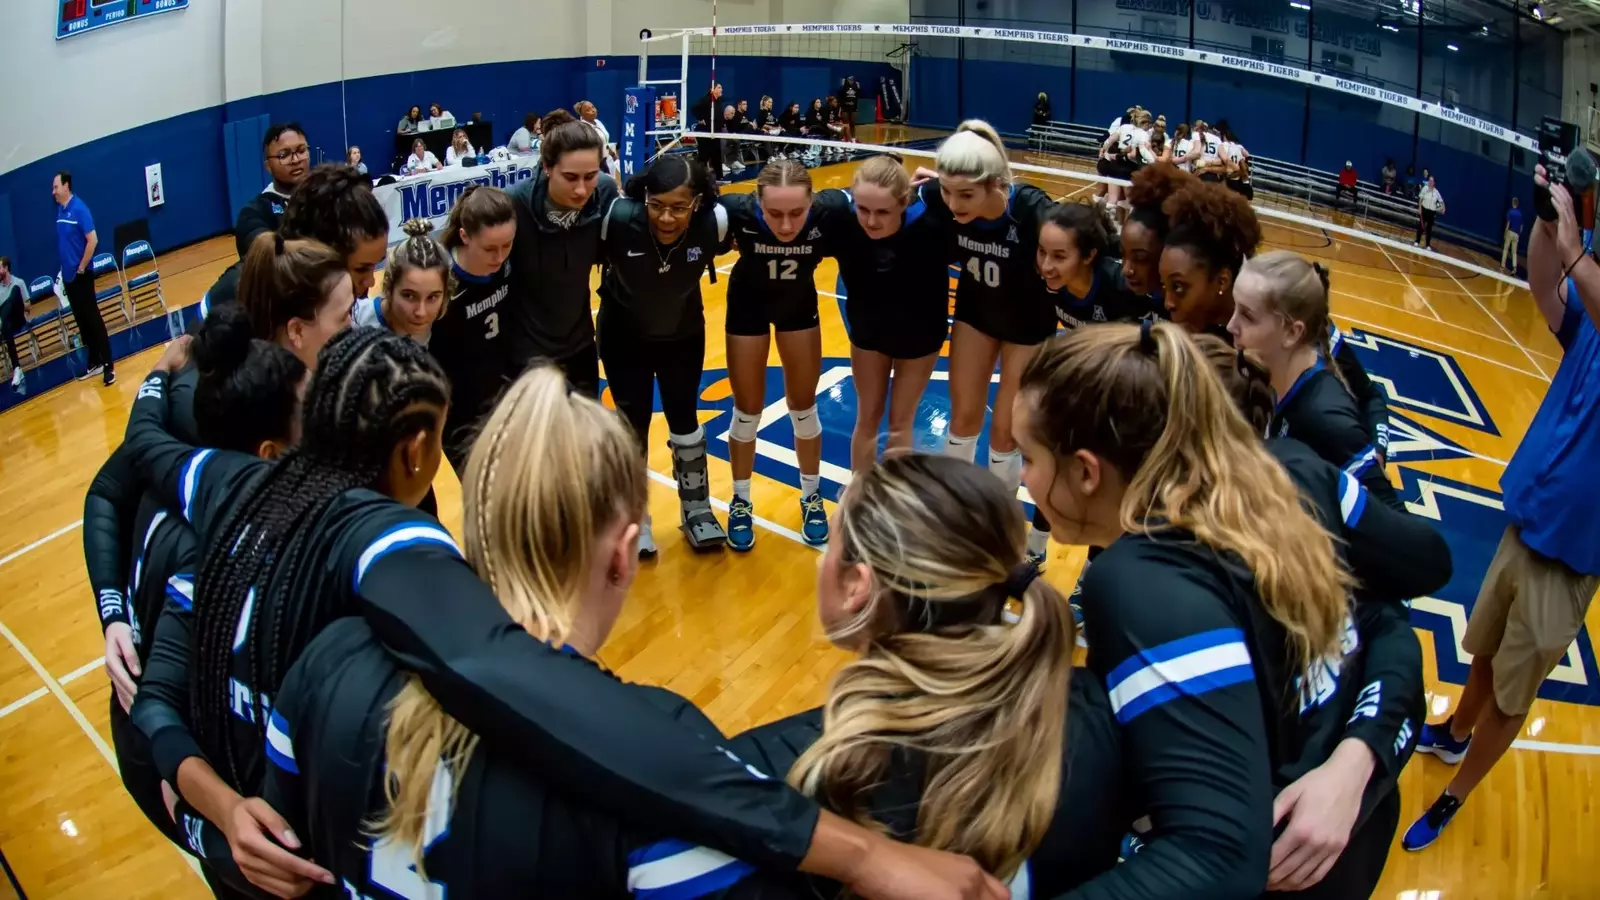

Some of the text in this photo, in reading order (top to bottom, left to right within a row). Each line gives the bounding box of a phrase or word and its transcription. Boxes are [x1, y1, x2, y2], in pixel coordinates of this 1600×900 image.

[105, 10, 125, 20] PERIOD
[68, 19, 89, 31] BONUS
[893, 25, 960, 34] MEMPHIS TIGERS
[994, 29, 1069, 42] MEMPHIS TIGERS
[1106, 39, 1185, 57] MEMPHIS TIGERS
[1222, 56, 1300, 78] MEMPHIS TIGERS
[1335, 79, 1408, 105] MEMPHIS TIGERS
[1440, 108, 1504, 136] MEMPHIS TIGERS
[1123, 134, 1133, 146] 2
[1204, 142, 1216, 155] 15
[125, 244, 148, 256] Memphis
[754, 243, 813, 257] Memphis
[957, 234, 1010, 258] Memphis
[93, 257, 112, 268] emphis
[767, 259, 799, 280] 12
[966, 256, 1000, 288] 40
[465, 284, 509, 320] Memphis
[484, 312, 500, 340] 3
